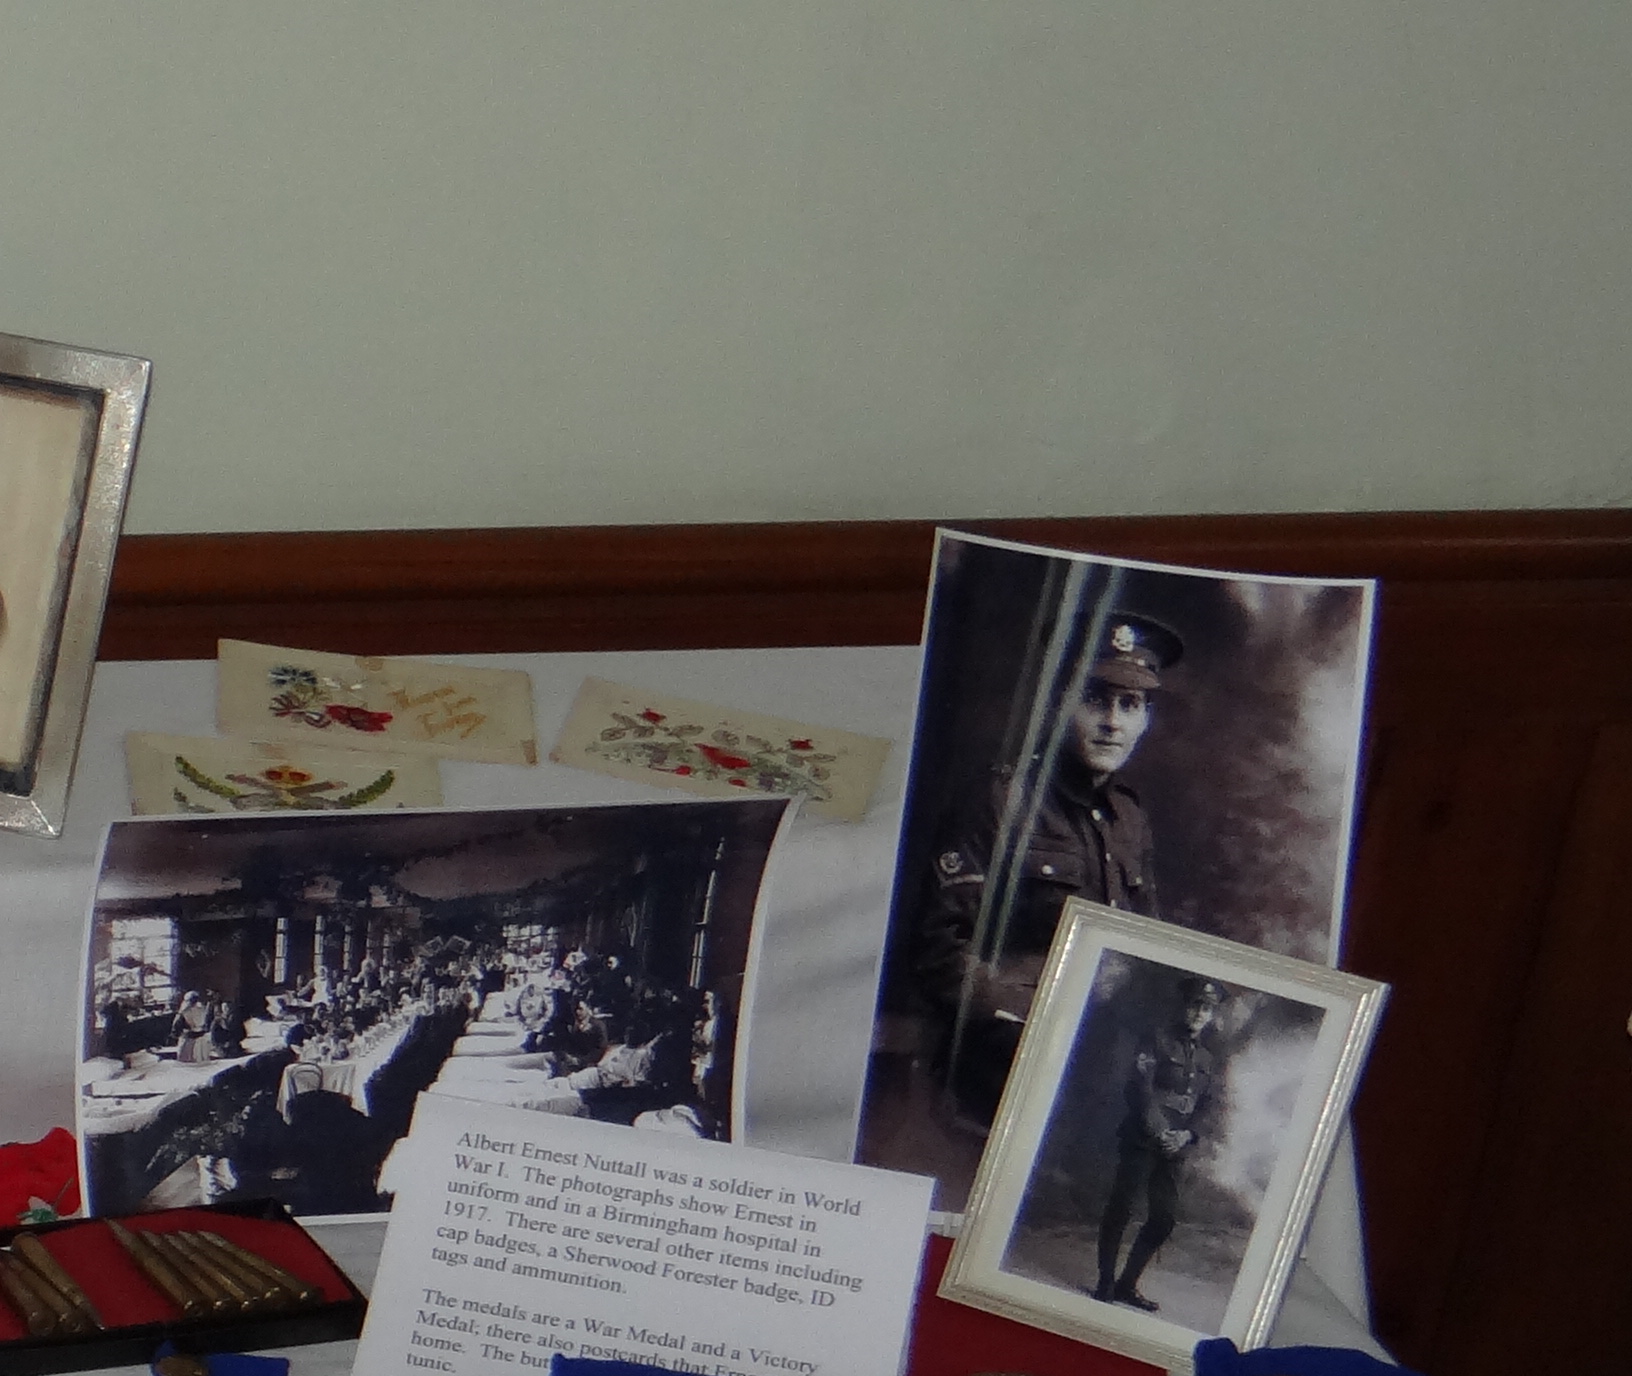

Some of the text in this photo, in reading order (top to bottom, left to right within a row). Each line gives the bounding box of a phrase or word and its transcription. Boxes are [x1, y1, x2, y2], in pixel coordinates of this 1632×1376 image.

[454, 1153, 493, 1175] War
[522, 1165, 556, 1187] The
[560, 1175, 674, 1208] photographs
[678, 1195, 728, 1217] show
[733, 1203, 794, 1229] Ernest
[799, 1214, 817, 1234] in
[457, 1132, 862, 1217] Albert Ernest Nuttall was a soldier in World
[447, 1180, 822, 1258] uniform and in a Birmingham hospital in
[505, 1210, 557, 1235] There
[561, 1225, 590, 1241] are
[595, 1231, 660, 1254] several
[665, 1242, 714, 1265] other
[718, 1250, 769, 1272] items
[774, 1259, 864, 1293] including
[431, 1246, 628, 1295] tags and ammunition.
[436, 1225, 835, 1308] cap badges, a Sherwood Forester badge, ID
[410, 1329, 467, 1355] home.
[480, 1342, 516, 1363] The
[422, 1288, 458, 1309] The
[461, 1298, 528, 1322] medals
[531, 1312, 561, 1327] are
[565, 1318, 576, 1331] a
[583, 1317, 622, 1339] War
[625, 1326, 686, 1350] Medal
[690, 1340, 727, 1358] and
[730, 1347, 741, 1361] a
[485, 1323, 533, 1345] there
[536, 1333, 574, 1352] also
[579, 1343, 667, 1368] postcards
[671, 1357, 710, 1376] that
